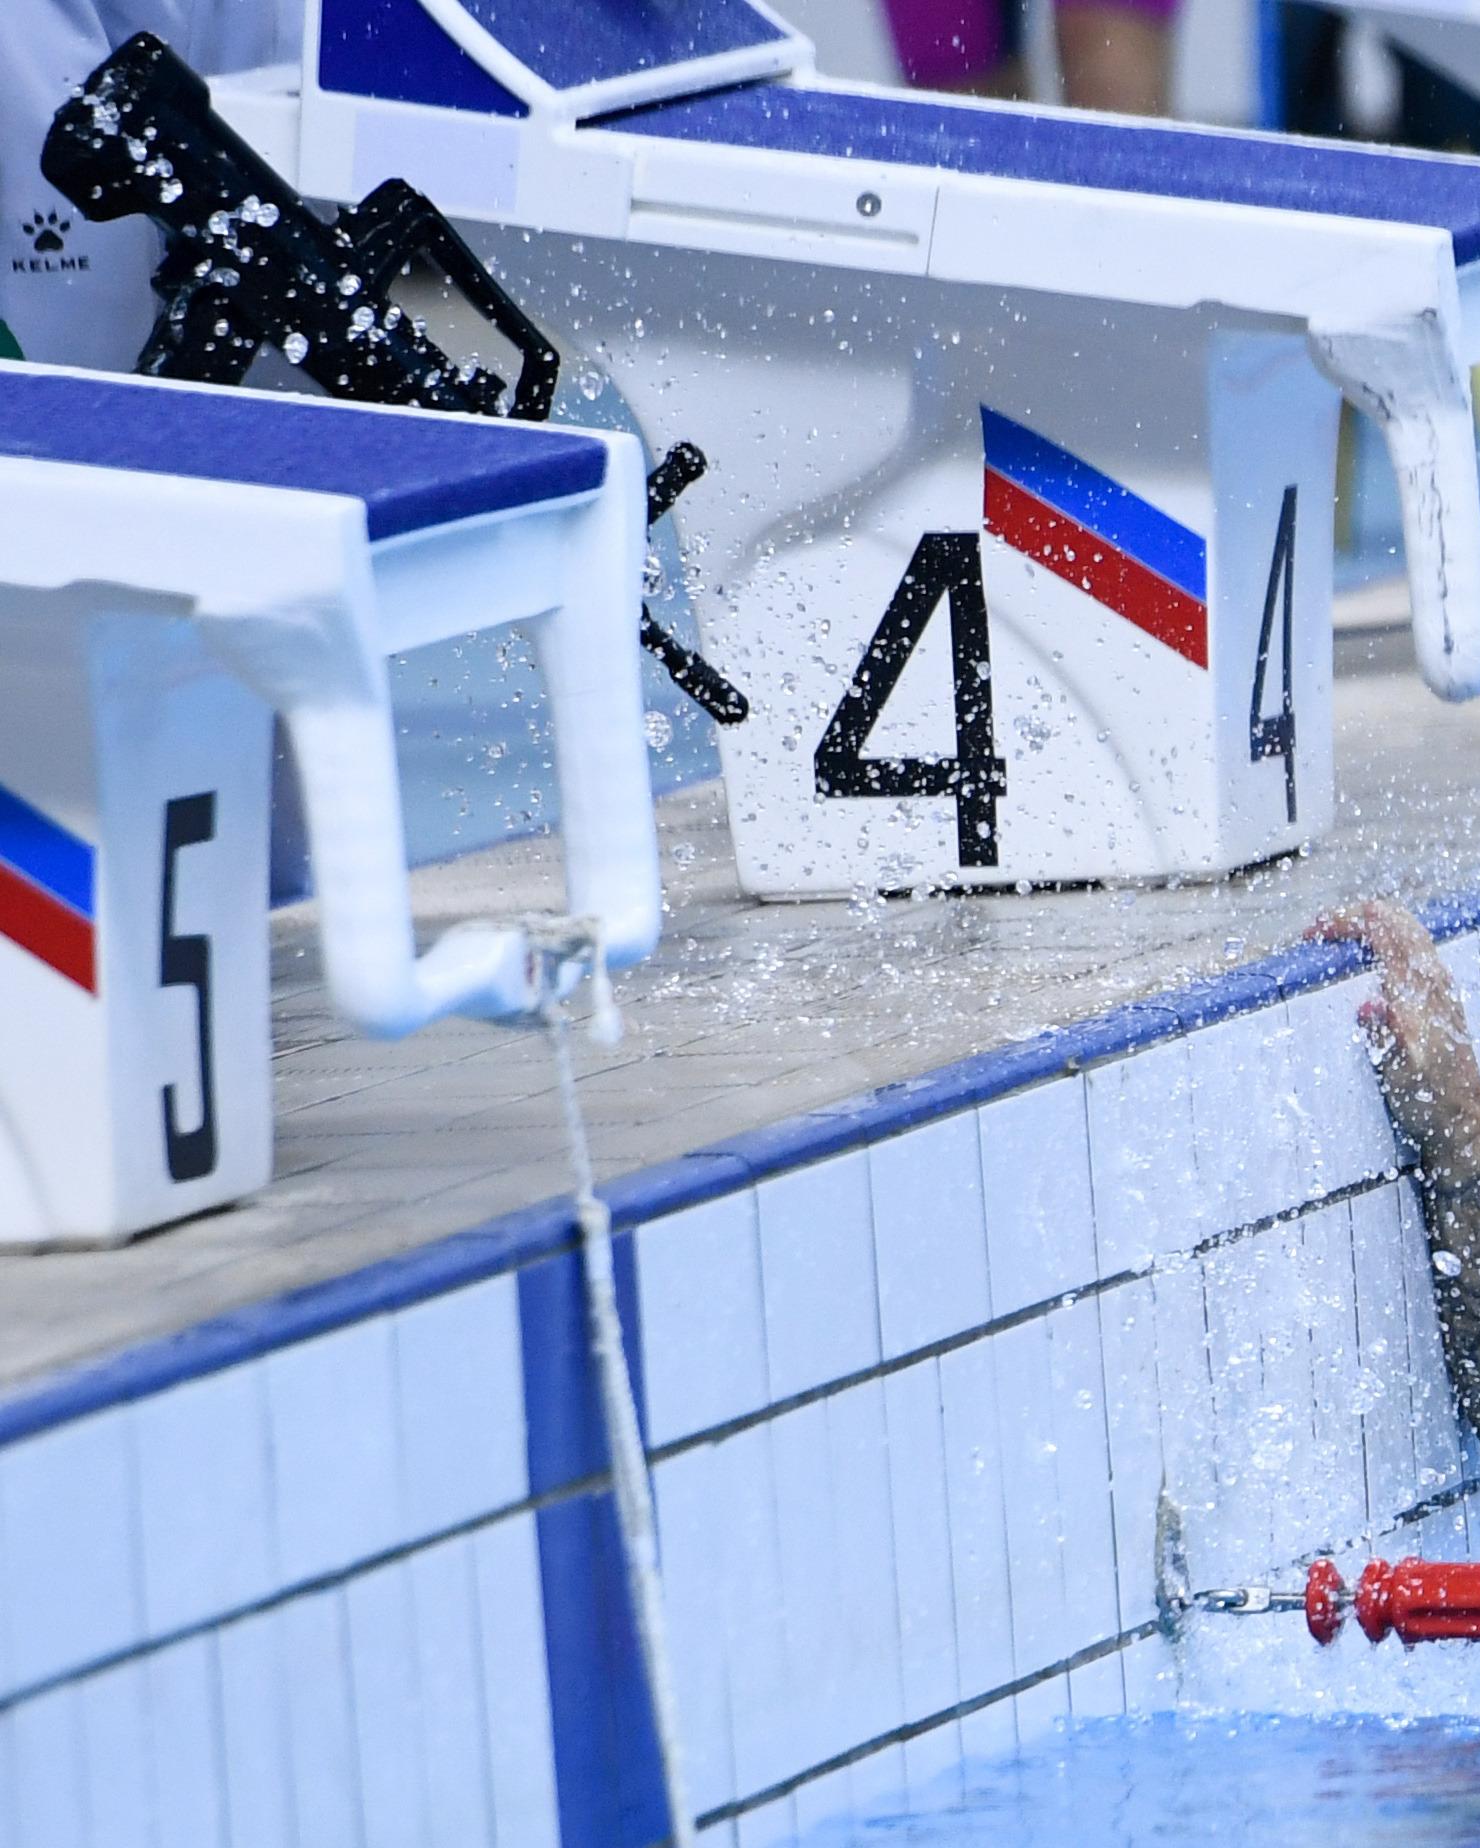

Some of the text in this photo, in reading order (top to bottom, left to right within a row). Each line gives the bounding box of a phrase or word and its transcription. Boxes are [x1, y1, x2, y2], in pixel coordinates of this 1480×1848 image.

[12, 256, 90, 273] KELME
[814, 532, 1007, 867] 4
[1250, 484, 1298, 822] 4
[160, 790, 217, 1184] 5
